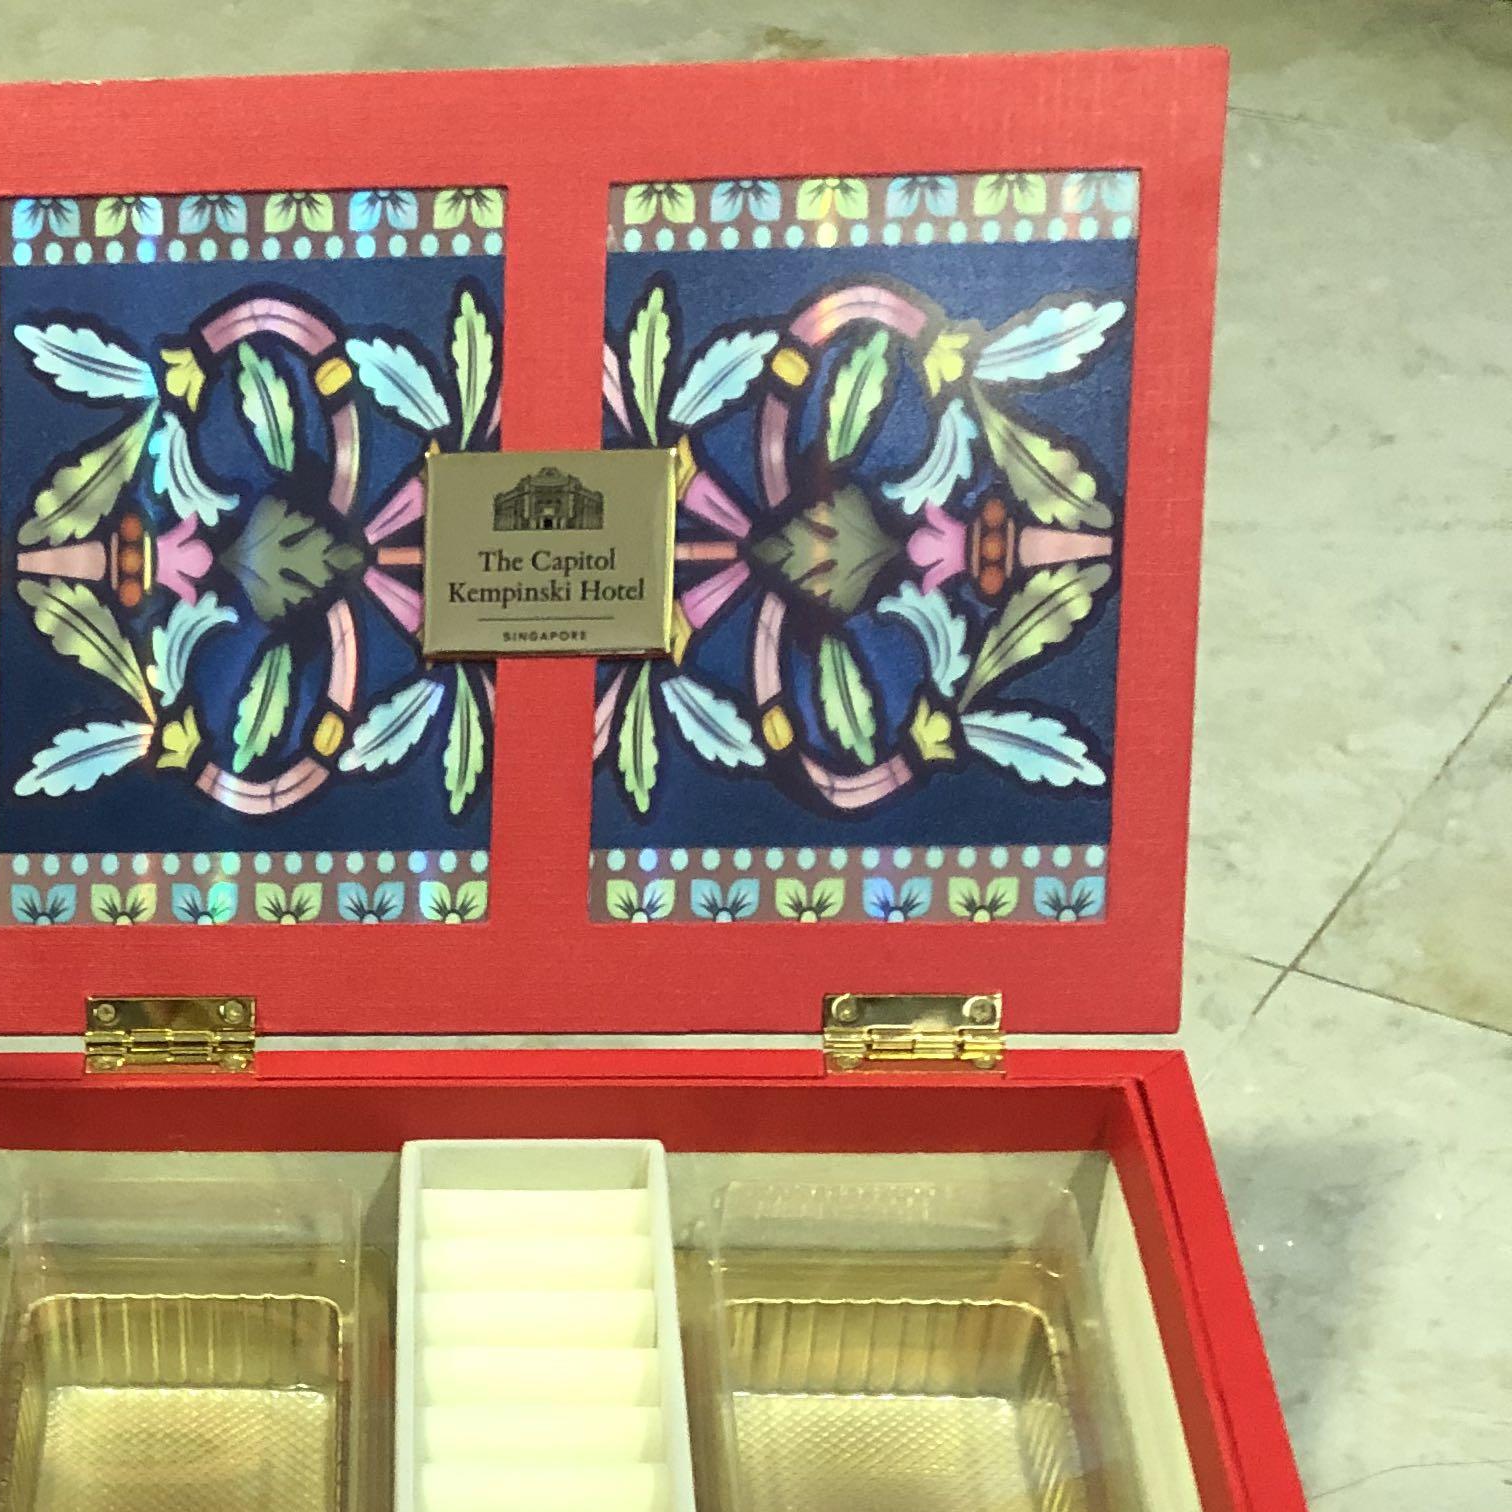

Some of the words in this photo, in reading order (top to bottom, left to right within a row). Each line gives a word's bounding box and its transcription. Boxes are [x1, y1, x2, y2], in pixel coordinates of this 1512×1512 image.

[478, 550, 524, 572] The
[531, 547, 616, 577] Capitol
[448, 579, 572, 609] Kempinski
[581, 578, 645, 602] Hotel
[502, 631, 588, 642] SINGAPORE
